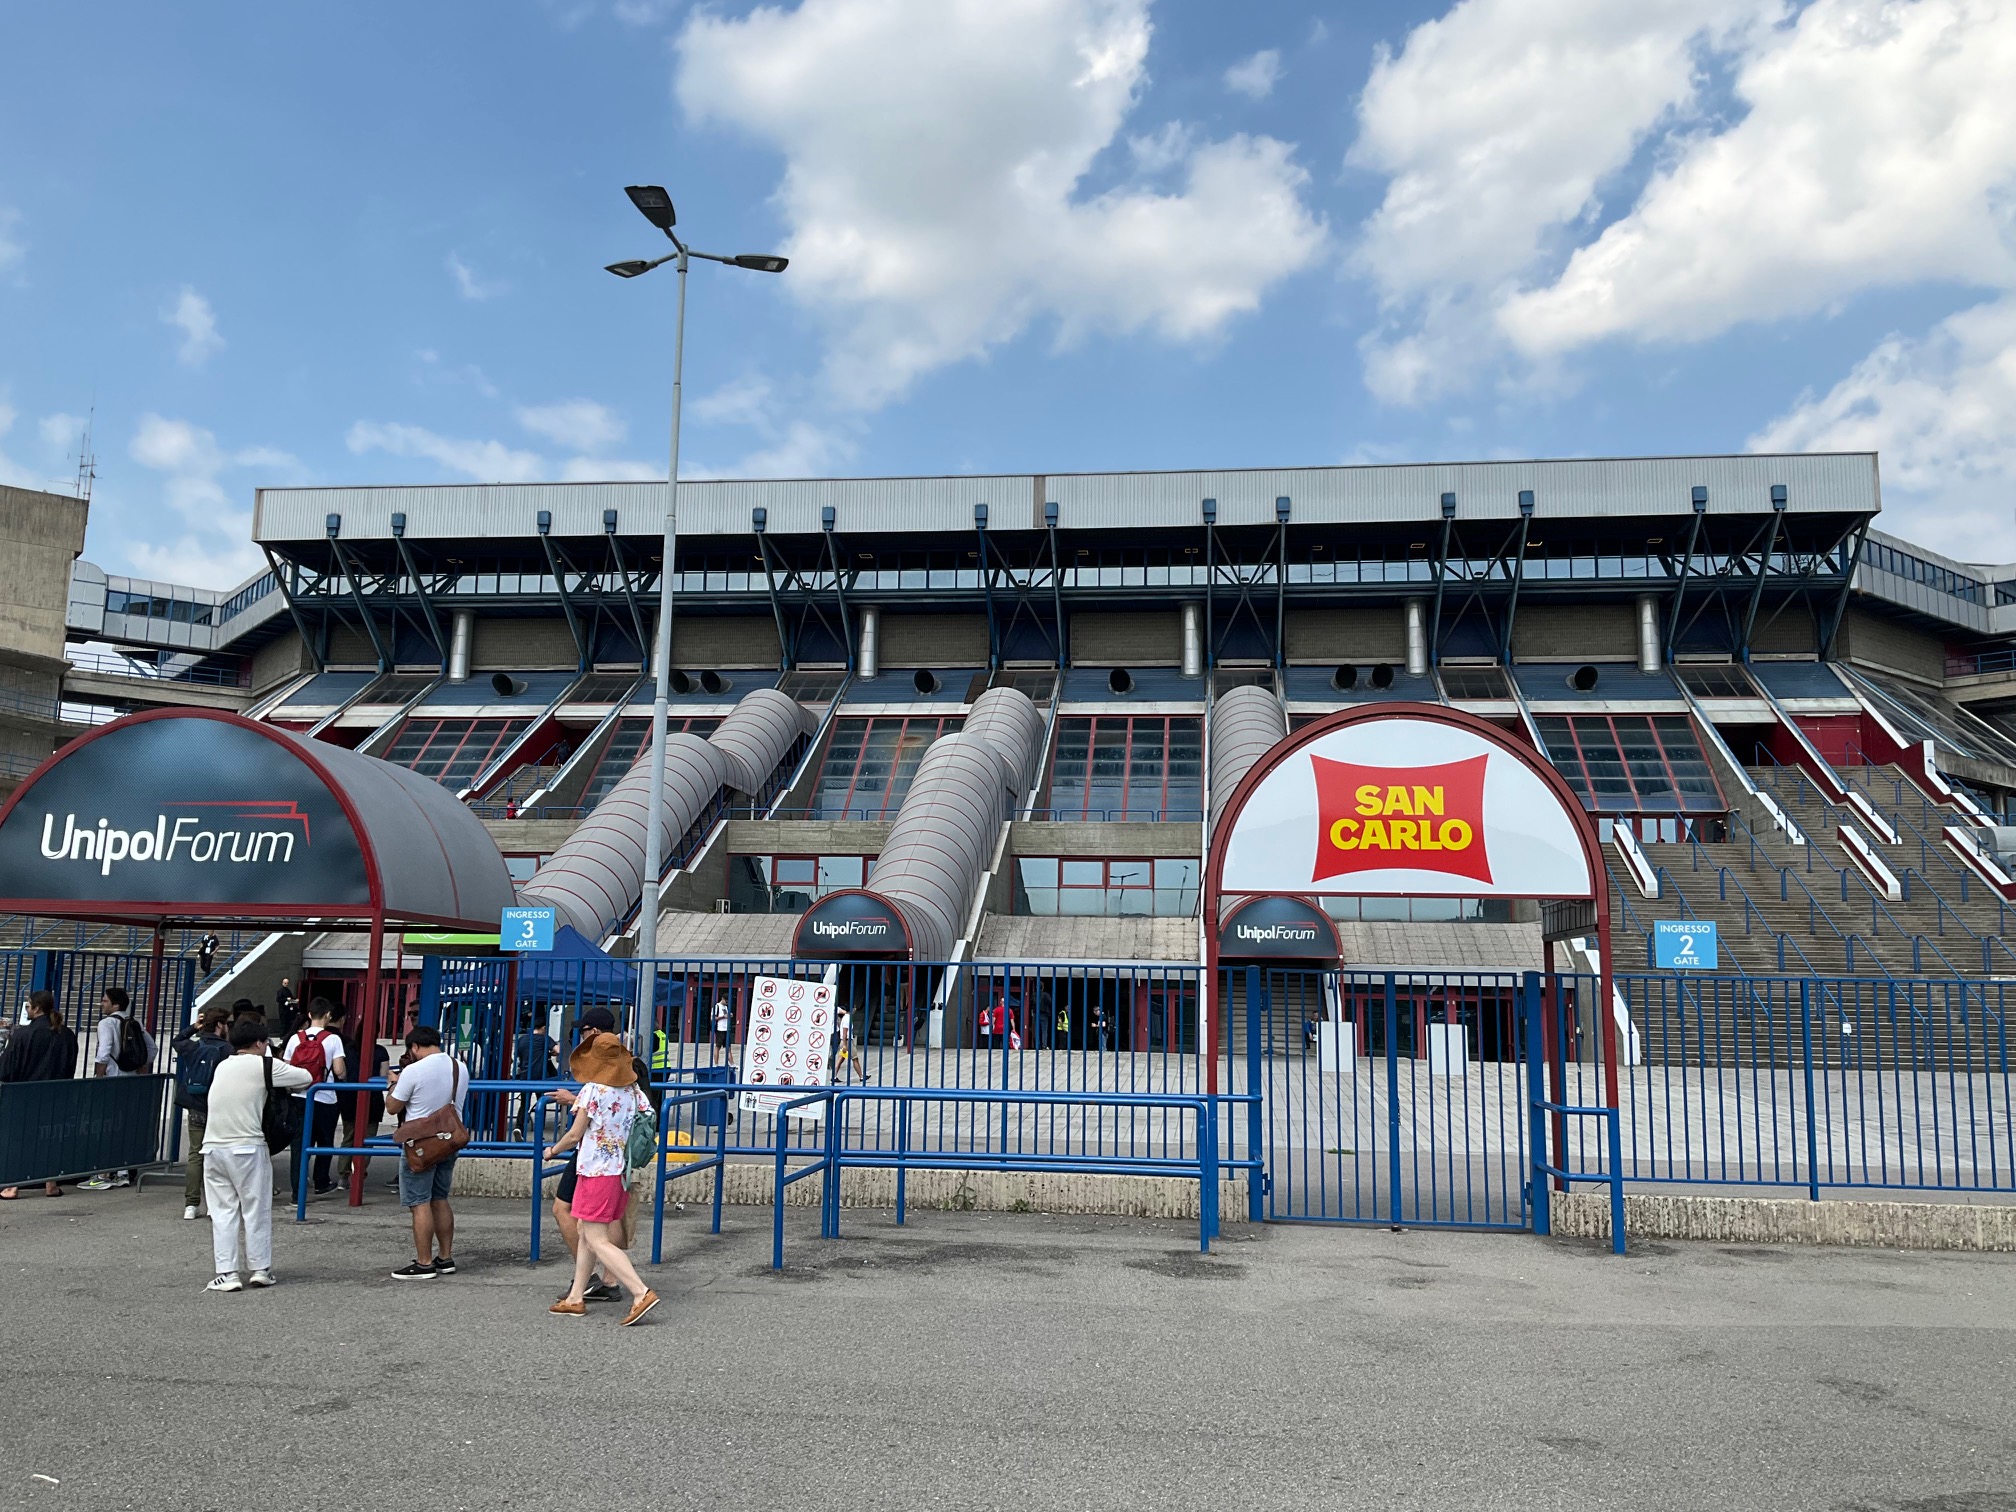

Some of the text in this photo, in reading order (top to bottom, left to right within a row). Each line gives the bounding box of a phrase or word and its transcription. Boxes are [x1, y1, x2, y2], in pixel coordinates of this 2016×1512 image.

[1354, 784, 1445, 817] SAN
[1329, 818, 1473, 851] CARLO
[40, 813, 294, 876] UnipolForum
[506, 910, 550, 919] INGRESSO
[521, 920, 534, 939] 3
[813, 920, 887, 939] UnipolForum
[1237, 924, 1315, 944] UnipolForum
[1660, 924, 1711, 934] INGRESSO
[515, 940, 538, 948] GATE
[1679, 934, 1695, 955] 2
[1673, 956, 1700, 965] GATE
